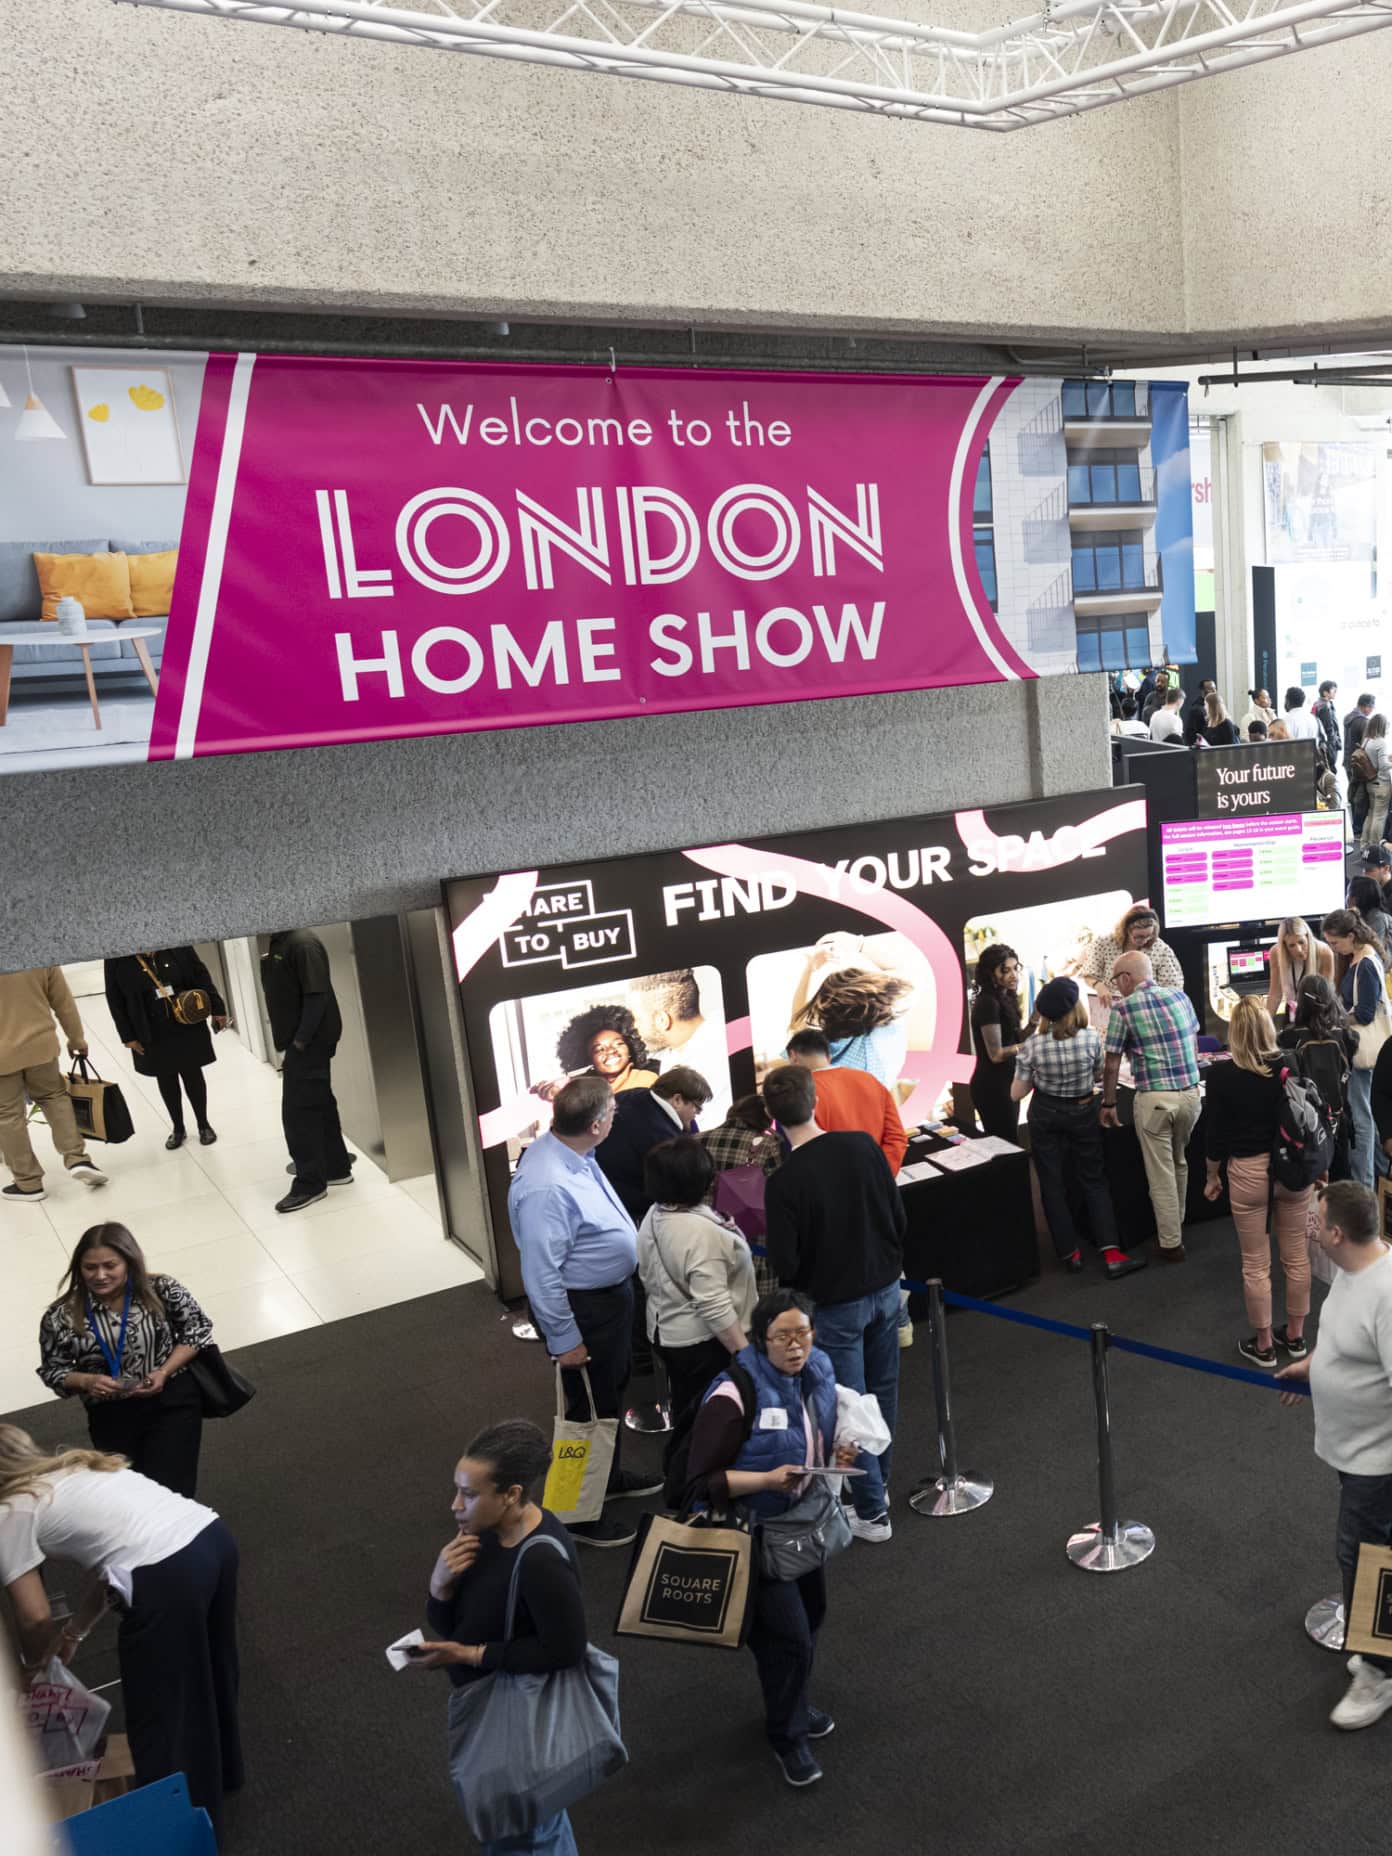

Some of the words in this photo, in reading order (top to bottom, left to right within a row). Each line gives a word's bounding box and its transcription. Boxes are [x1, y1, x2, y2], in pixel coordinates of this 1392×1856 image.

[416, 396, 653, 447] Welcome
[668, 407, 711, 447] to
[727, 401, 793, 447] the
[315, 483, 885, 599] LONDON
[334, 617, 622, 702] HOME
[648, 600, 887, 678] SHOW
[1216, 767, 1251, 786] Your
[1252, 763, 1296, 782] future
[1217, 791, 1229, 809] is
[1230, 790, 1271, 812] yours
[661, 869, 798, 927] FIND
[815, 845, 953, 900] YOUR
[516, 891, 584, 918] ARE
[514, 933, 550, 954] TO
[573, 927, 621, 951] BUY
[559, 1446, 586, 1459] L&Q
[660, 1573, 721, 1591] SQUARE
[662, 1587, 712, 1605] ROOTS
